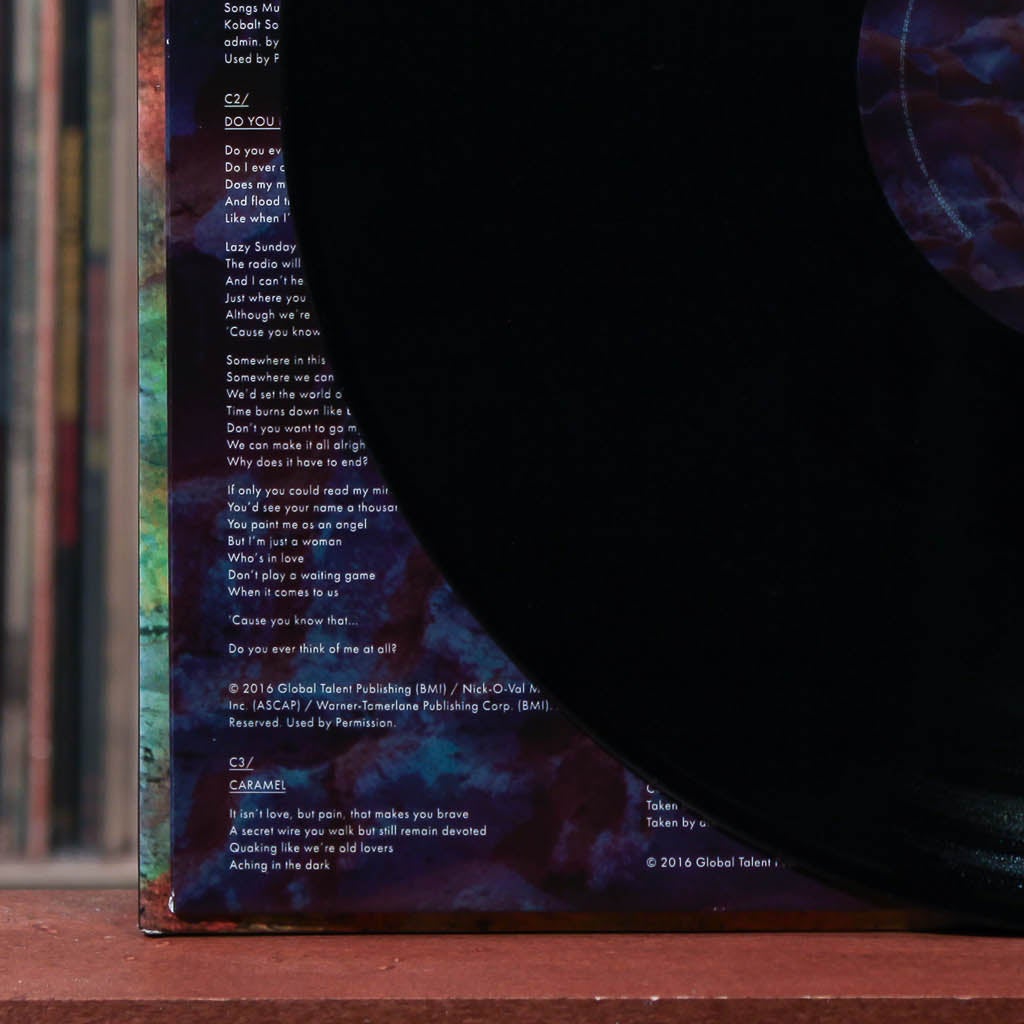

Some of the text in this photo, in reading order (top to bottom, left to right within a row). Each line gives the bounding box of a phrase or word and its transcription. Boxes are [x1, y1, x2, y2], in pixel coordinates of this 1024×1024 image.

[224, 36, 279, 49] admin. by
[224, 94, 248, 104] C2/
[225, 116, 274, 126] DO YOU
[226, 241, 296, 254] Lazy Sunday
[226, 355, 326, 365] Somewhere in this
[227, 456, 368, 470] Why does it have to end?
[227, 518, 247, 529] You
[251, 520, 278, 532] paint
[336, 518, 367, 532] angel
[228, 569, 258, 580] Don't
[262, 569, 285, 582] play
[301, 571, 340, 583] waiting
[345, 573, 375, 583] game
[229, 682, 524, 696] © 2016 Global Talent Publishing (BMI) / Nick-O-Val
[229, 716, 396, 730] Reserved. Used by Permission.
[230, 756, 254, 768] C3/
[229, 780, 286, 790] CARAMEL
[646, 800, 678, 810] Taken
[229, 859, 330, 872] Aching in the dark
[646, 856, 770, 868] © 2016 Global Talent
